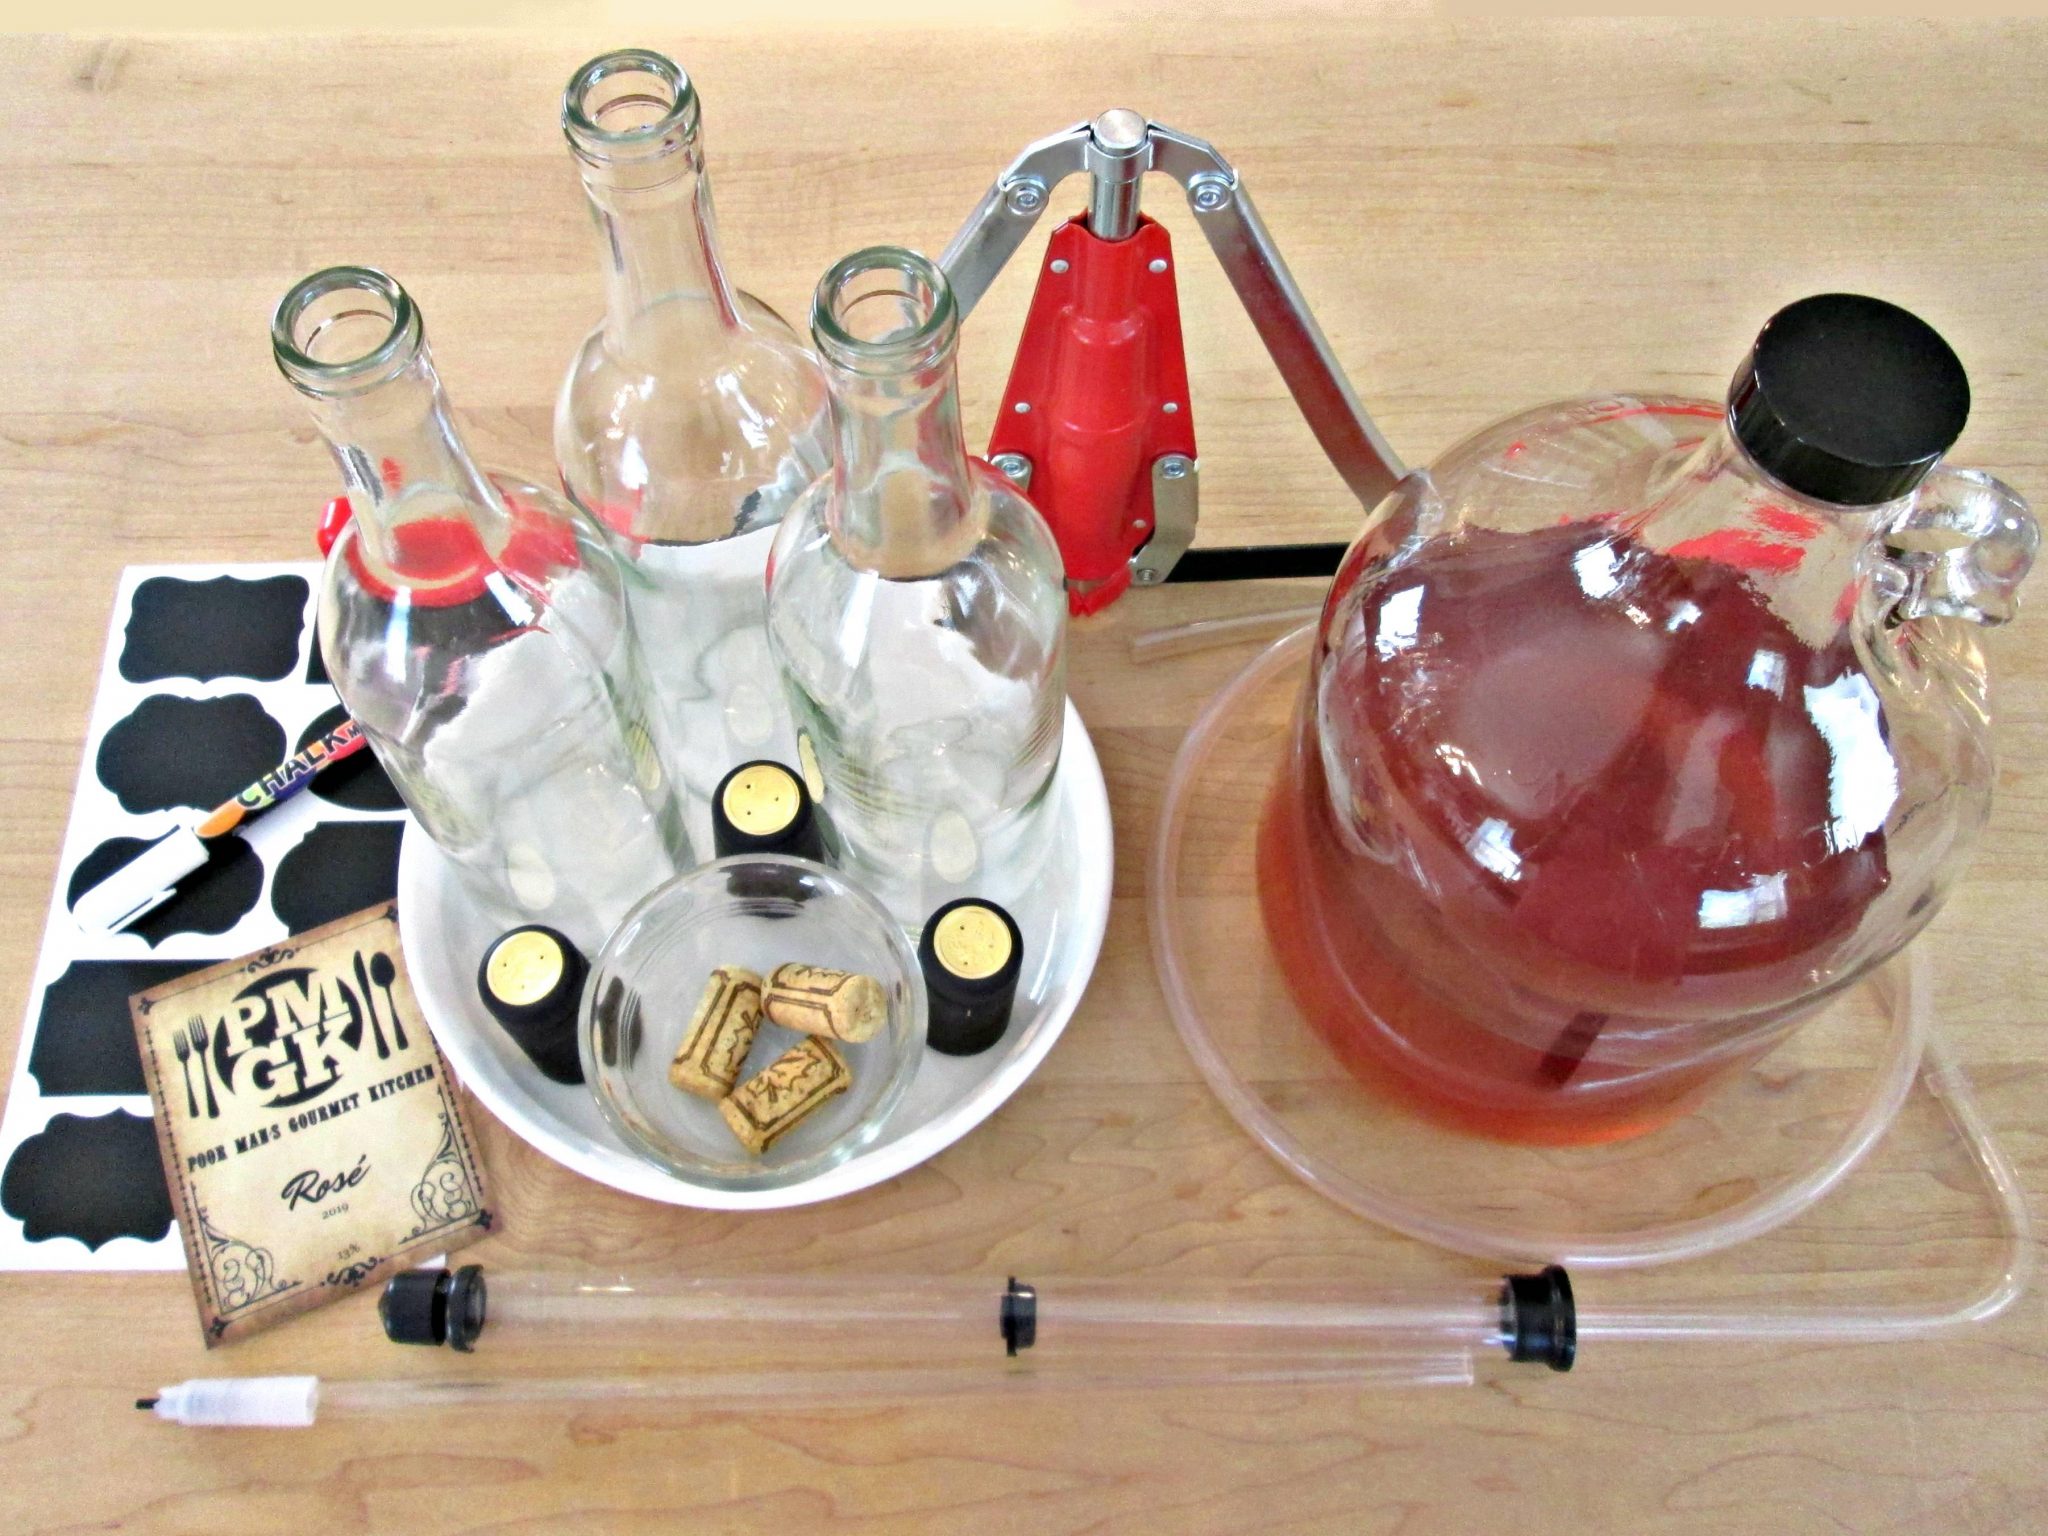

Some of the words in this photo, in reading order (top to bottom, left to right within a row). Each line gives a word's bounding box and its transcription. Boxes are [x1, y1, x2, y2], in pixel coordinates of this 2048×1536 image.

[236, 732, 348, 807] CHALK
[222, 973, 350, 1057] PM
[231, 1012, 355, 1101] GK
[187, 1145, 227, 1173] POOR
[288, 1092, 360, 1132] GOURMET
[367, 1064, 436, 1102] KITCHEN
[281, 1154, 371, 1211] Rosé
[322, 1203, 349, 1219] 2019
